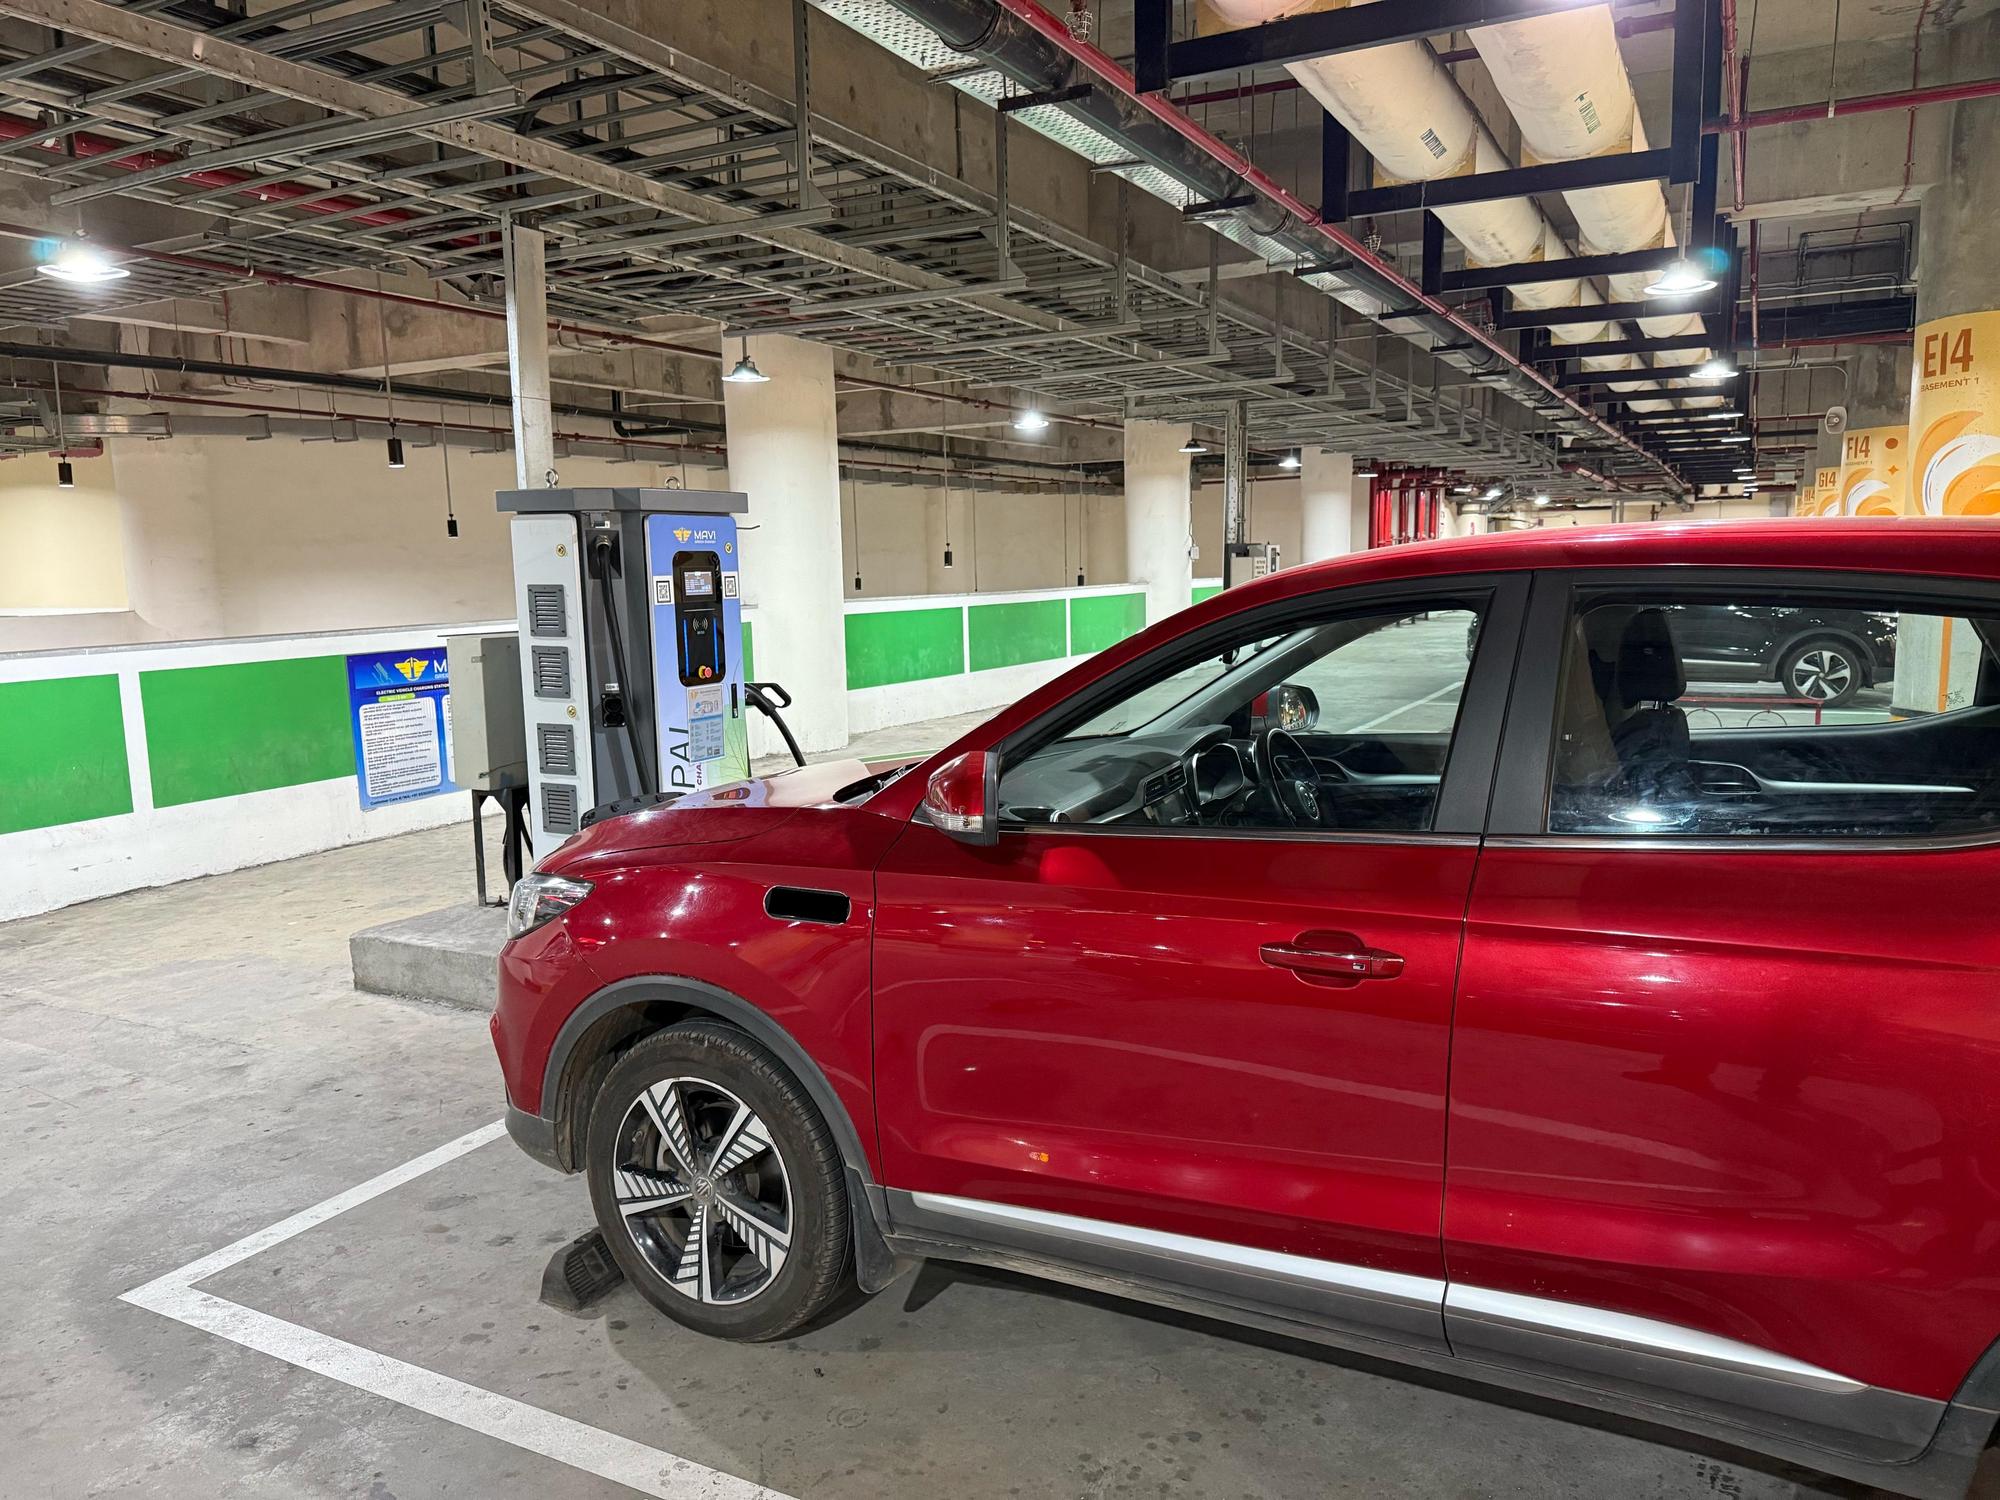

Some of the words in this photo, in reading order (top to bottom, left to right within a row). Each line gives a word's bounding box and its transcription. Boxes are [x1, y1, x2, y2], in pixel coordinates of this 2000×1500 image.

[1924, 328, 1974, 378] E14
[1920, 377, 1971, 392] BASEMENT
[1974, 377, 1979, 385] 1
[1847, 435, 1871, 460] F14
[1818, 471, 1836, 488] G14
[694, 529, 716, 540] MAVI
